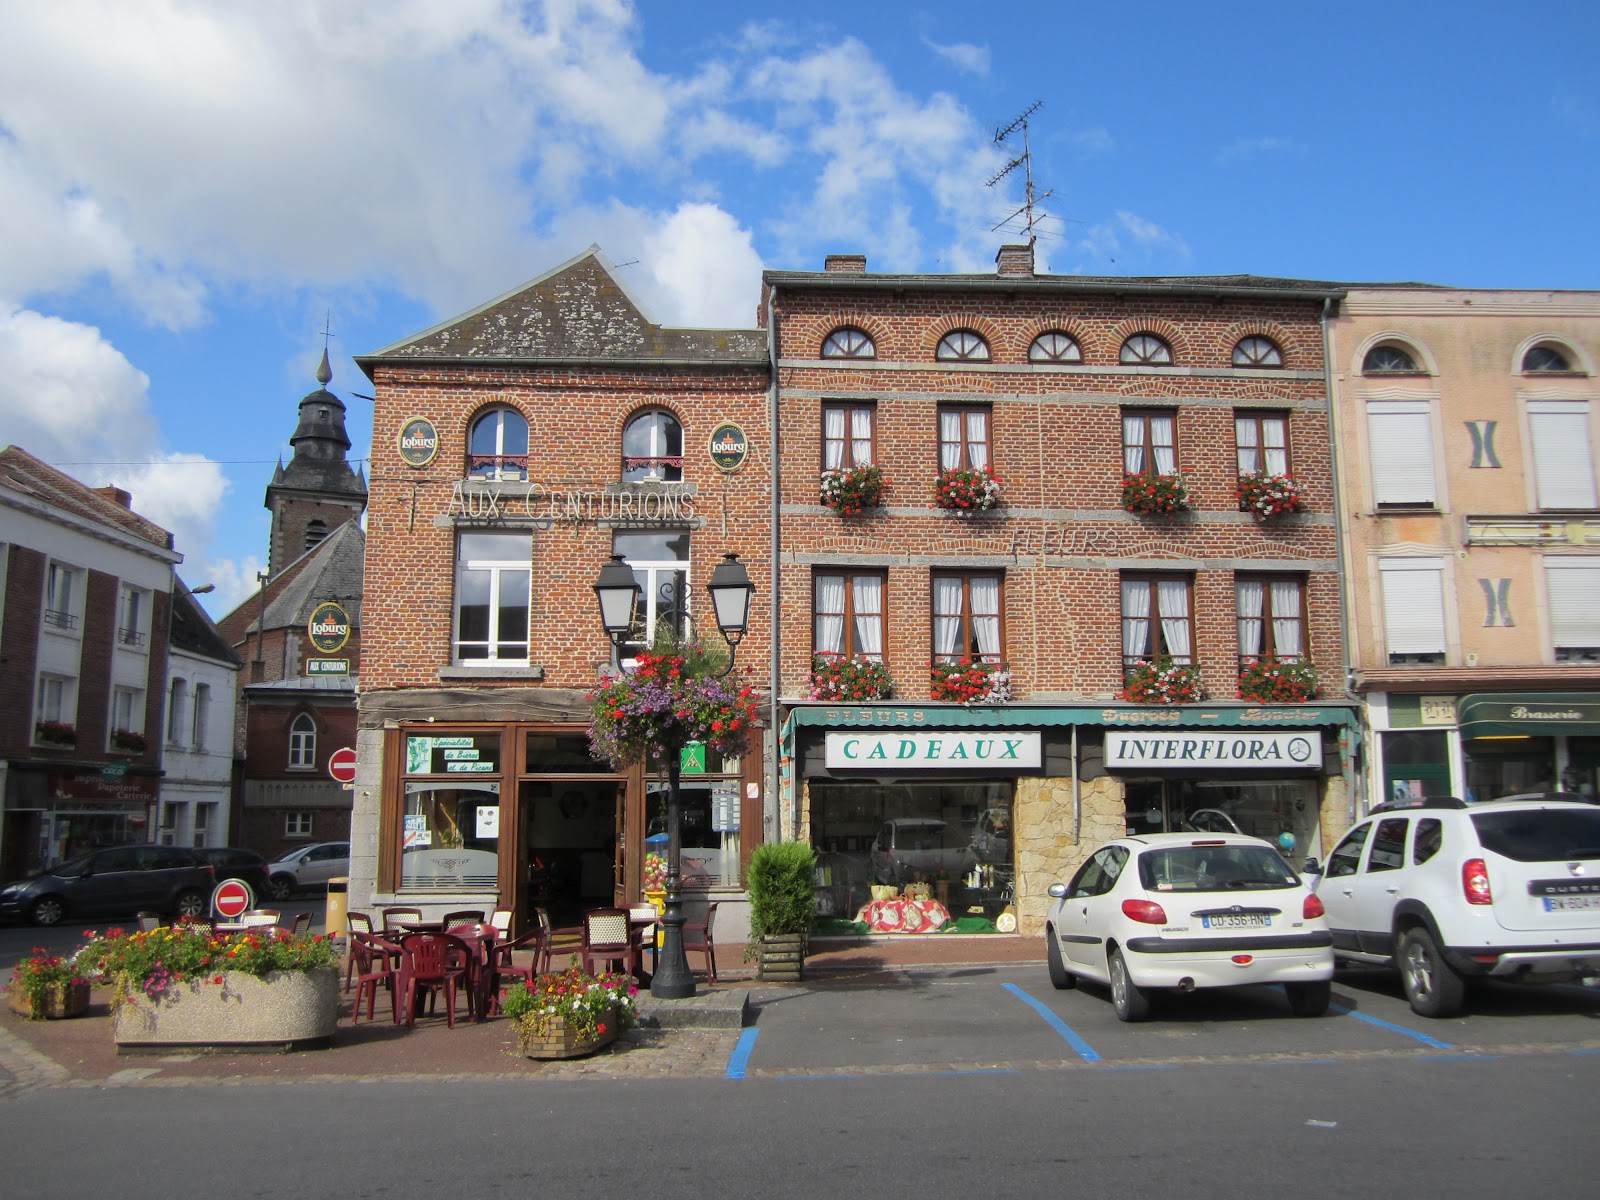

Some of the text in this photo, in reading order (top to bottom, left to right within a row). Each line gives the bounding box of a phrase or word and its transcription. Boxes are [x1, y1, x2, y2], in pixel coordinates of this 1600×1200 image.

[402, 436, 435, 448] Loburg
[712, 441, 745, 453] Loburg
[447, 481, 695, 519] AUX CENTURIONS
[1010, 529, 1120, 552] FLEURS
[312, 622, 347, 634] Loburg
[310, 661, 319, 671] AUX
[826, 710, 925, 722] FLEURS
[1510, 705, 1582, 719] Brasserie
[843, 739, 1024, 760] CADEAUX
[1116, 739, 1283, 761] INTERFLORA
